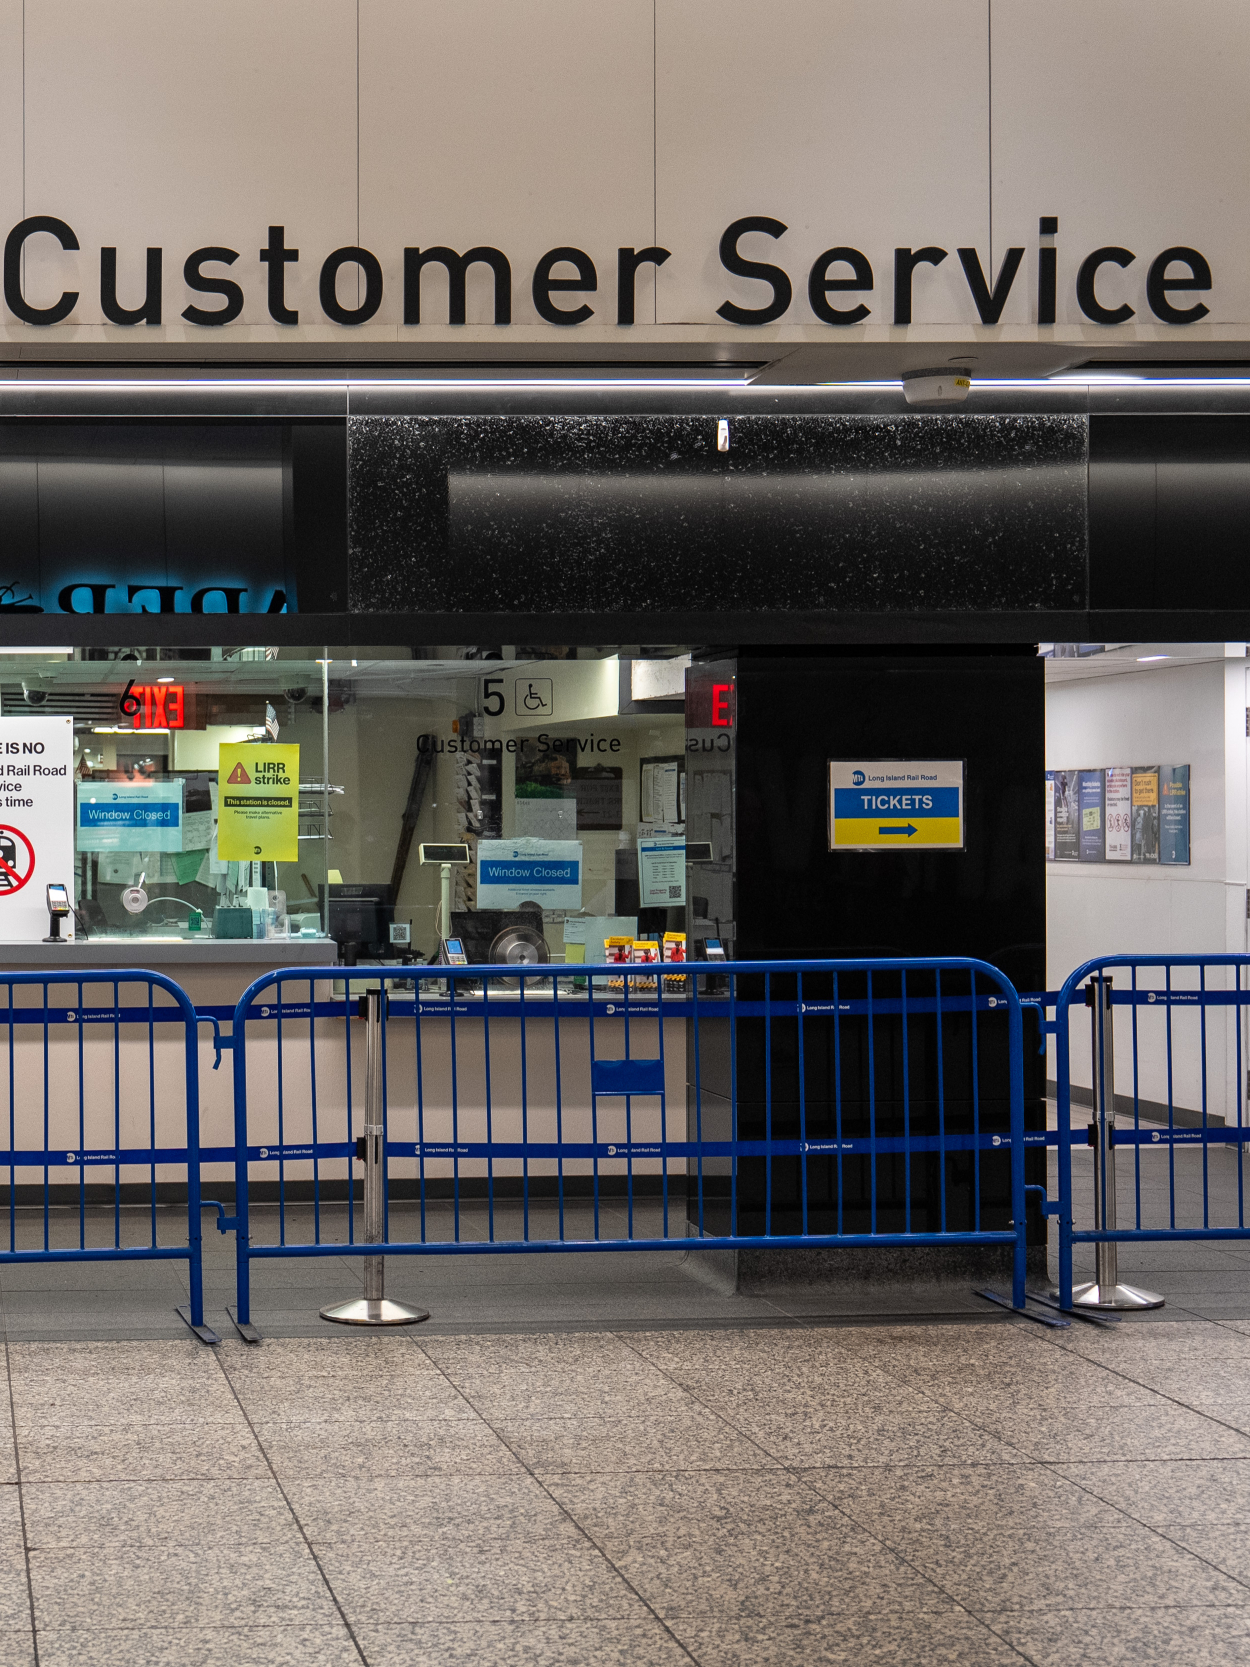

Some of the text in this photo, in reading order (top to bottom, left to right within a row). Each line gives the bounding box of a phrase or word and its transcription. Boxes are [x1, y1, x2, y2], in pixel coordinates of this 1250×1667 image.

[3, 215, 671, 325] Customer
[715, 216, 1212, 325] Service
[119, 678, 141, 716] 6
[483, 678, 505, 716] 5
[6, 742, 20, 754] IS
[22, 742, 46, 754] NO
[416, 733, 621, 753] Customer Service
[6, 764, 30, 776] Rail
[33, 764, 67, 776] Road
[255, 762, 286, 773] LIRR
[255, 774, 290, 785] strike
[5, 796, 34, 808] time
[861, 795, 932, 809] TICKETS
[88, 809, 170, 820] Window Closed
[489, 867, 570, 877] Window Closed
